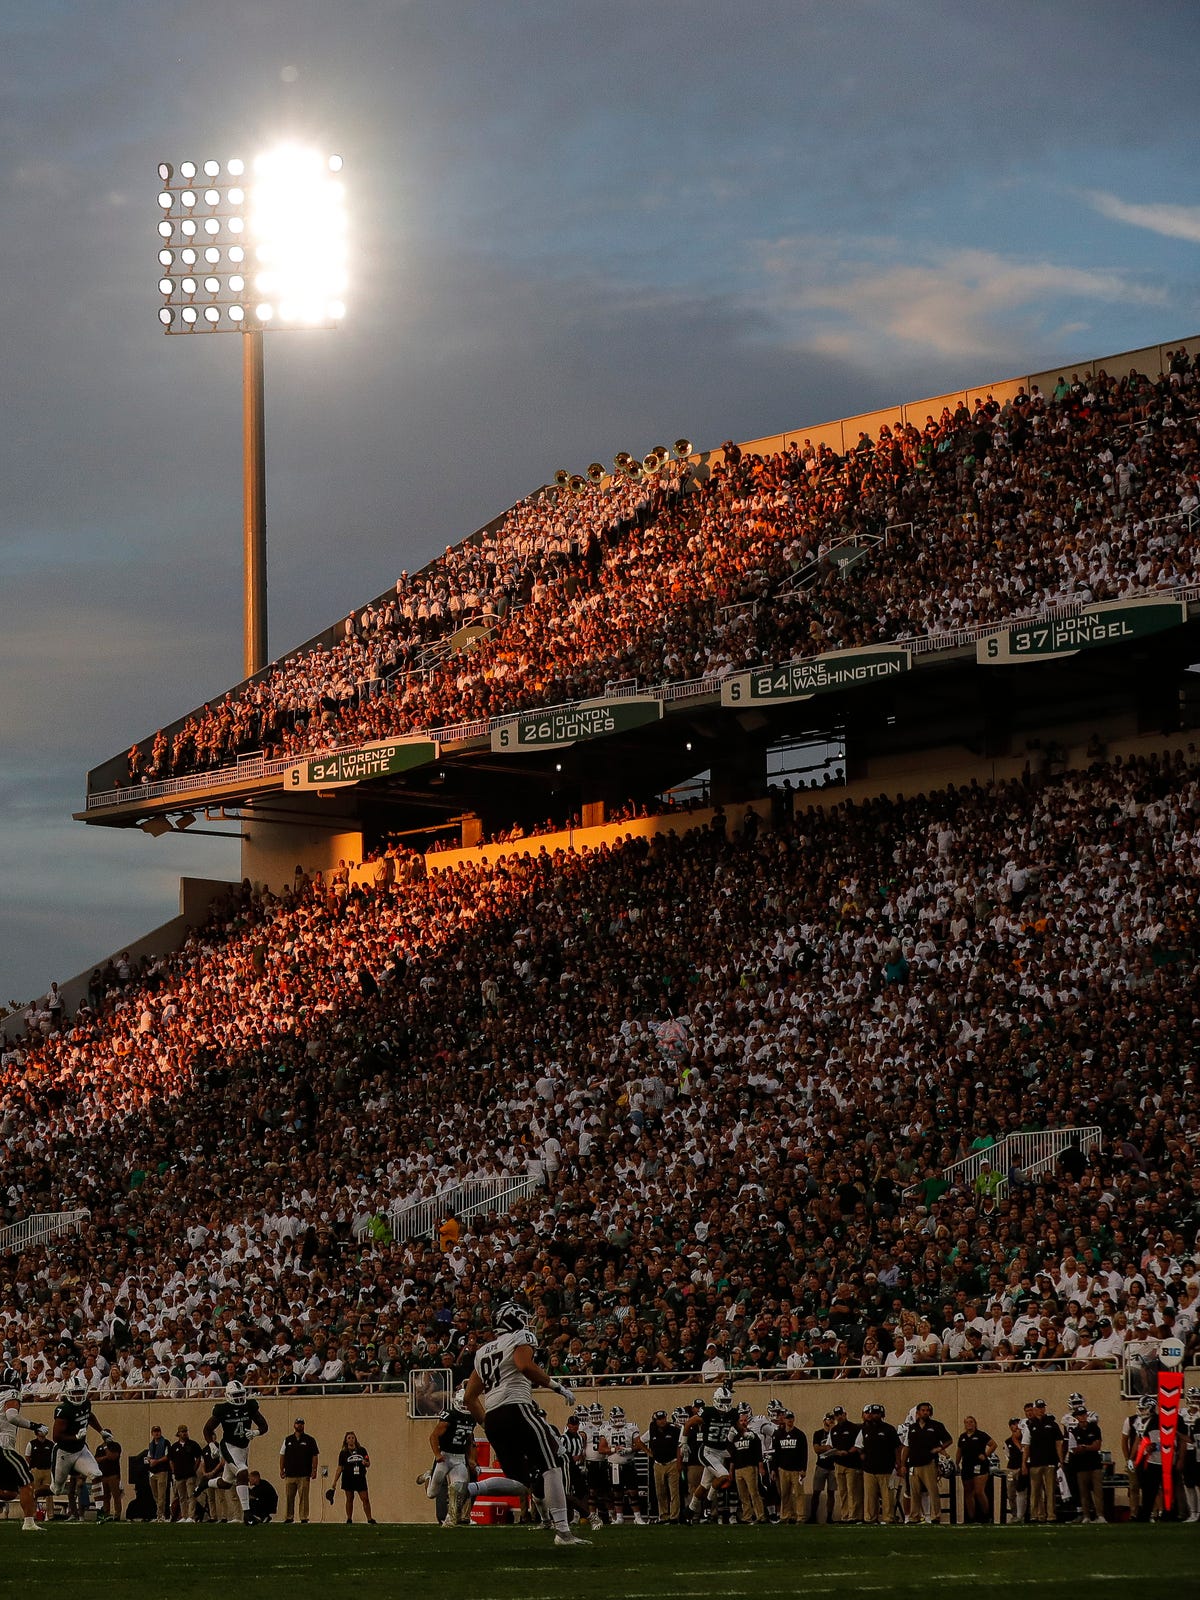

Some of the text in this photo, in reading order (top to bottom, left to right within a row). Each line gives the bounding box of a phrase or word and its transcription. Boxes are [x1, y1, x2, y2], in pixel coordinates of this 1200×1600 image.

[1056, 614, 1099, 632] JOHN
[1016, 629, 1049, 651] 37
[1056, 621, 1133, 647] PINGEL
[987, 638, 999, 658] S
[792, 663, 826, 678] GENE
[793, 660, 900, 690] WASHINGTON
[731, 682, 741, 700] S
[758, 674, 789, 695] 84
[556, 708, 610, 726] CLINTON
[524, 722, 551, 741] 26
[556, 717, 615, 739] JONES
[500, 729, 509, 746] S
[342, 747, 396, 766] LORENZO
[313, 762, 338, 780] 34
[342, 758, 390, 778] WHITE
[291, 769, 300, 786] S
[481, 1351, 504, 1394] 87
[55, 1408, 63, 1417] 7
[233, 1421, 246, 1438] 4
[734, 1440, 750, 1448] WMU
